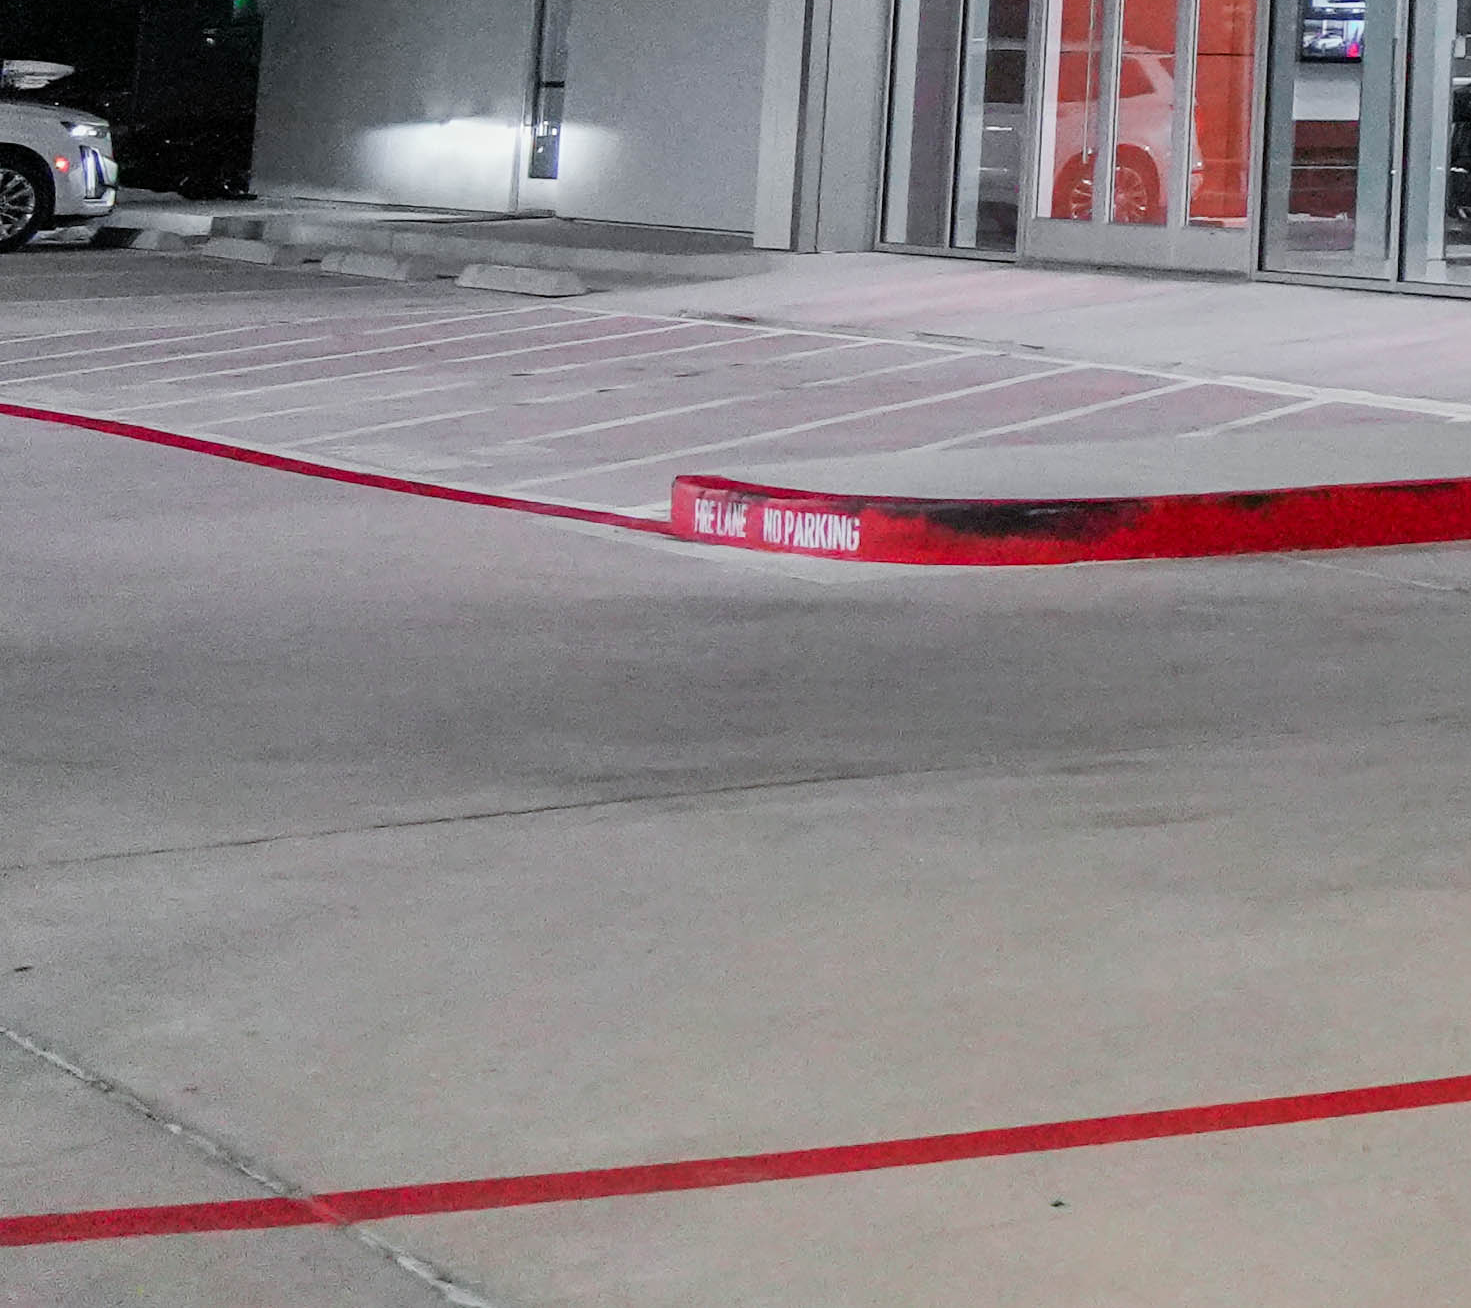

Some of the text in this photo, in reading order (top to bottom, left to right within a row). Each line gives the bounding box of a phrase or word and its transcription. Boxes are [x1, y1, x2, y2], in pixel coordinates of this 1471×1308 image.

[694, 498, 861, 552] FIRE LANE NO PARKING
